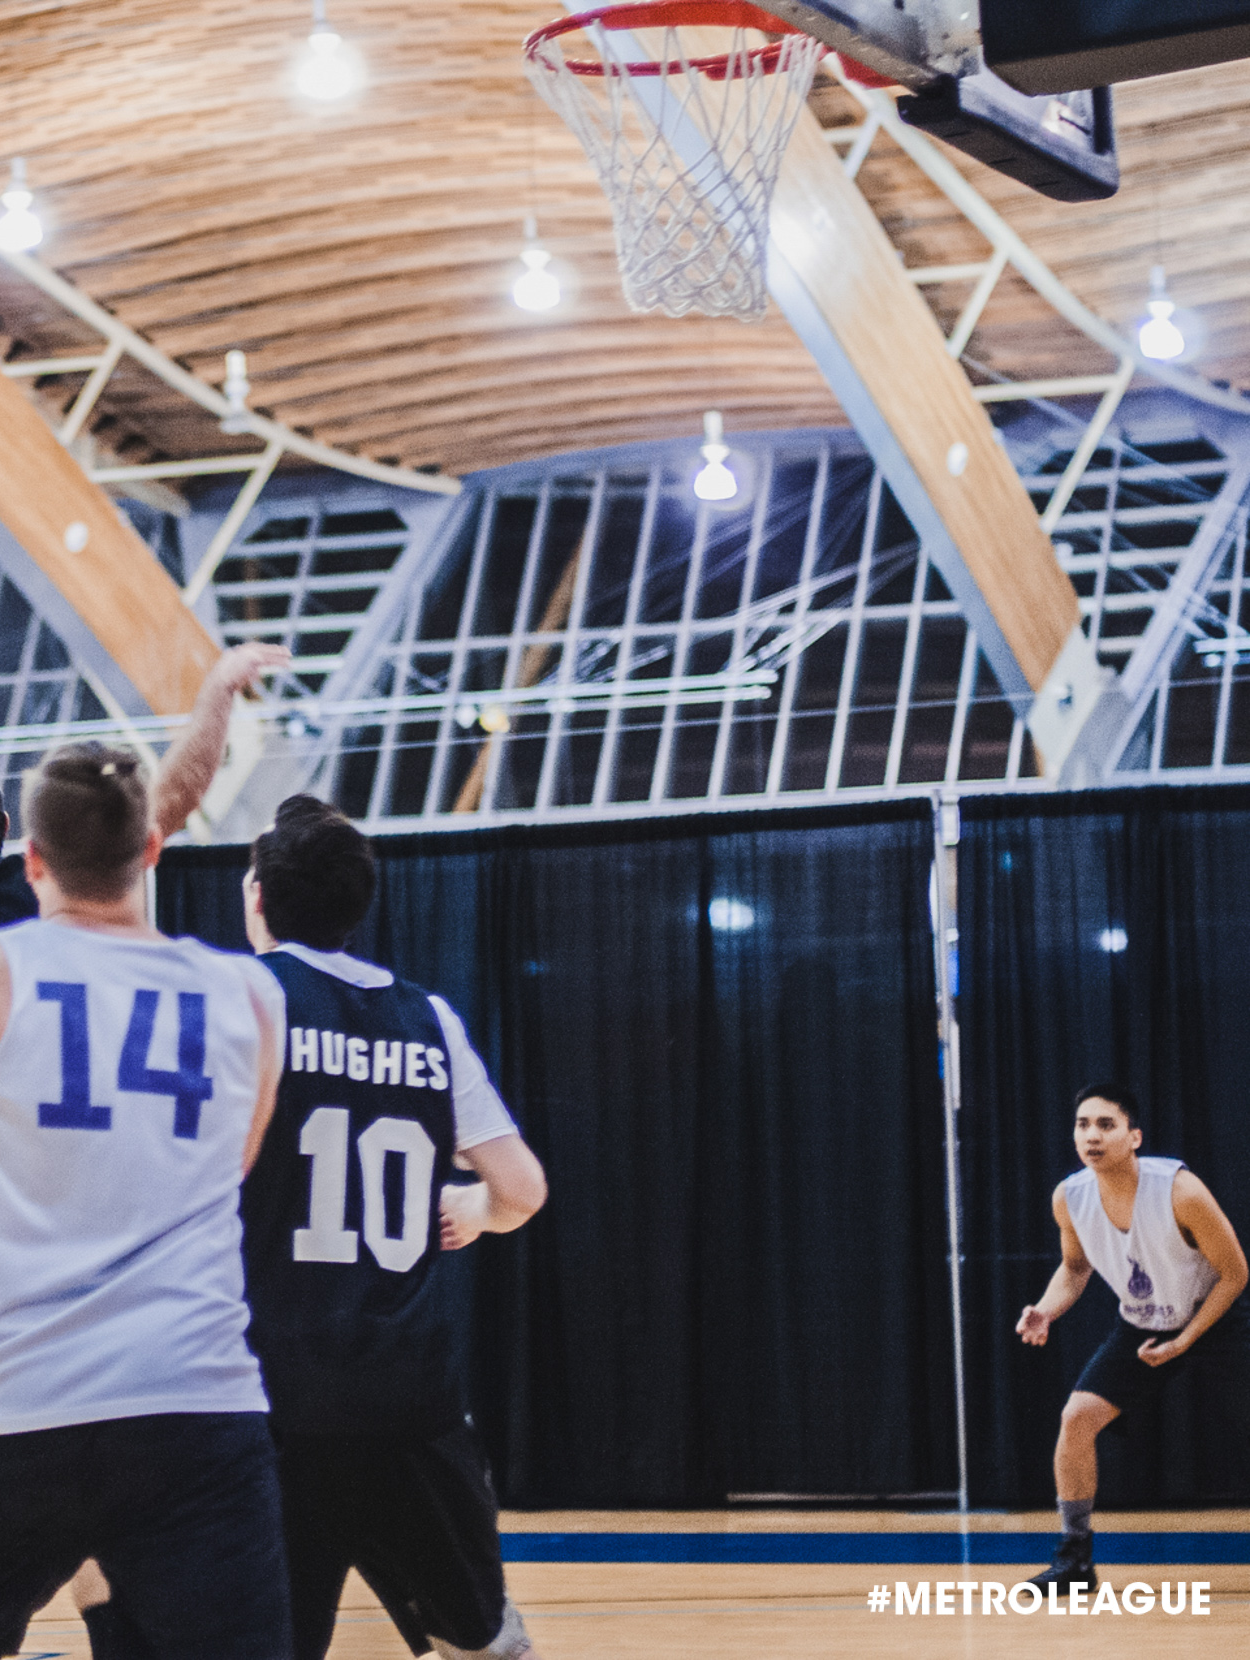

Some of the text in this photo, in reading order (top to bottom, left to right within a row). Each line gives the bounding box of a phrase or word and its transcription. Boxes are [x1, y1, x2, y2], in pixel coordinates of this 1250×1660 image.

[36, 980, 214, 1140] 14
[290, 1026, 450, 1091] HUGHES
[292, 1106, 437, 1273] 10
